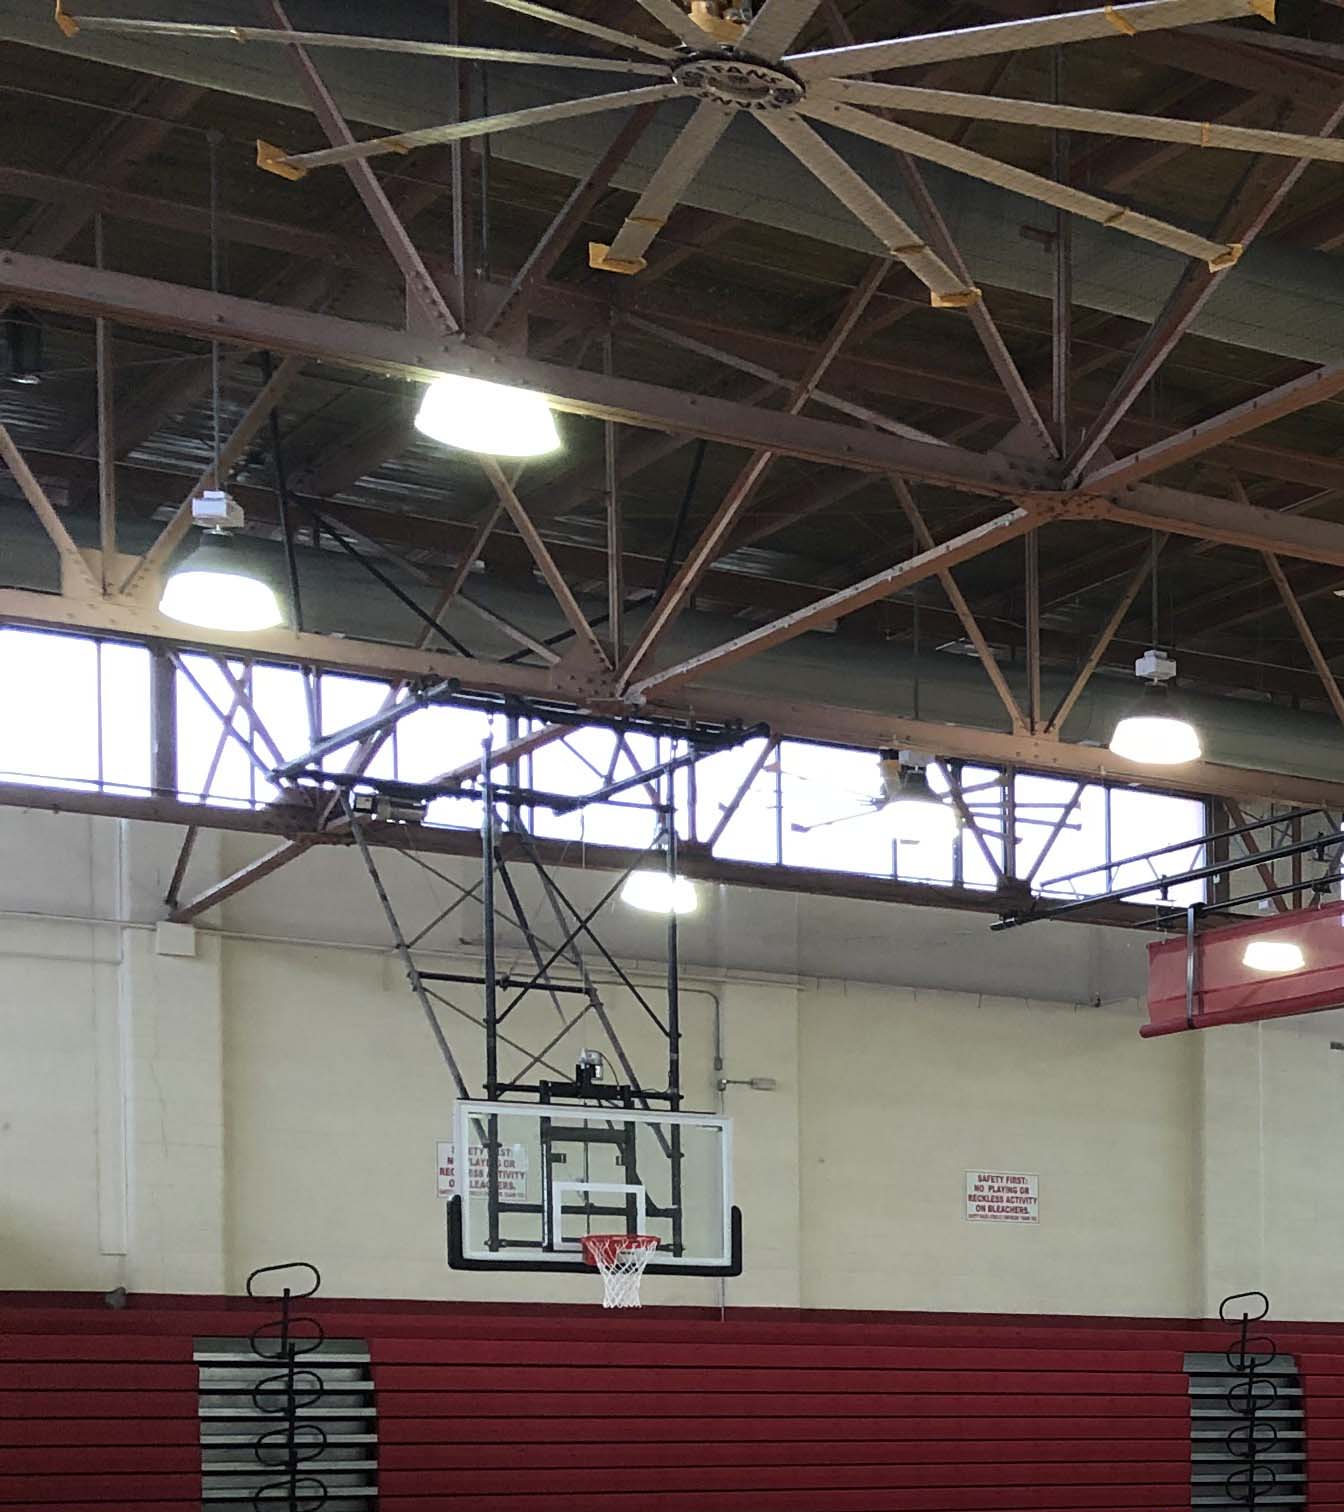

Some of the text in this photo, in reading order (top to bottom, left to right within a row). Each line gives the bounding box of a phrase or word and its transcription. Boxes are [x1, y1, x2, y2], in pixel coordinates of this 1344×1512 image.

[977, 1175, 1004, 1184] SAFETY
[974, 1184, 1030, 1195] NO PLAYING OR
[967, 1194, 1037, 1205] RECKLESS ACTIVITY
[975, 1204, 986, 1213] ON
